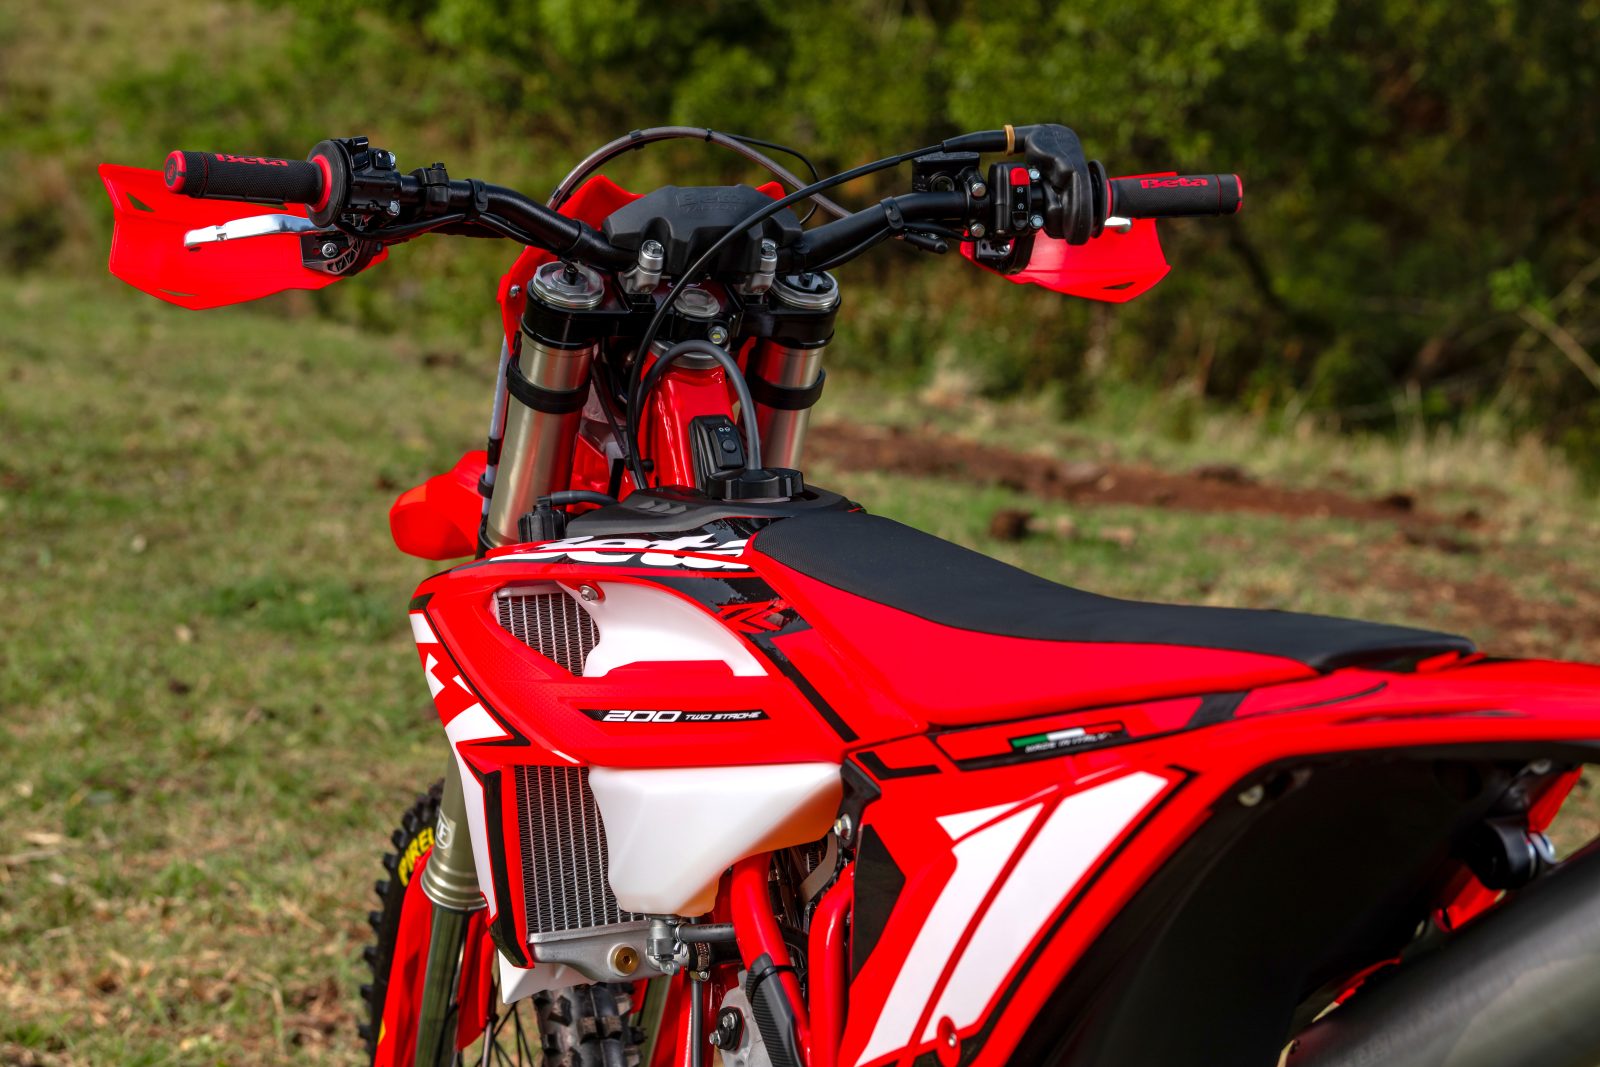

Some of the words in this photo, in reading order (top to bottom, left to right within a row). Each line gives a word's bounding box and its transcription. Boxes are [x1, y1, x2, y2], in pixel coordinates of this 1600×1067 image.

[1140, 177, 1209, 189] Beta
[602, 709, 682, 723] 200
[685, 713, 710, 721] TWO
[712, 711, 762, 720] STROKE
[1025, 742, 1056, 753] MADE
